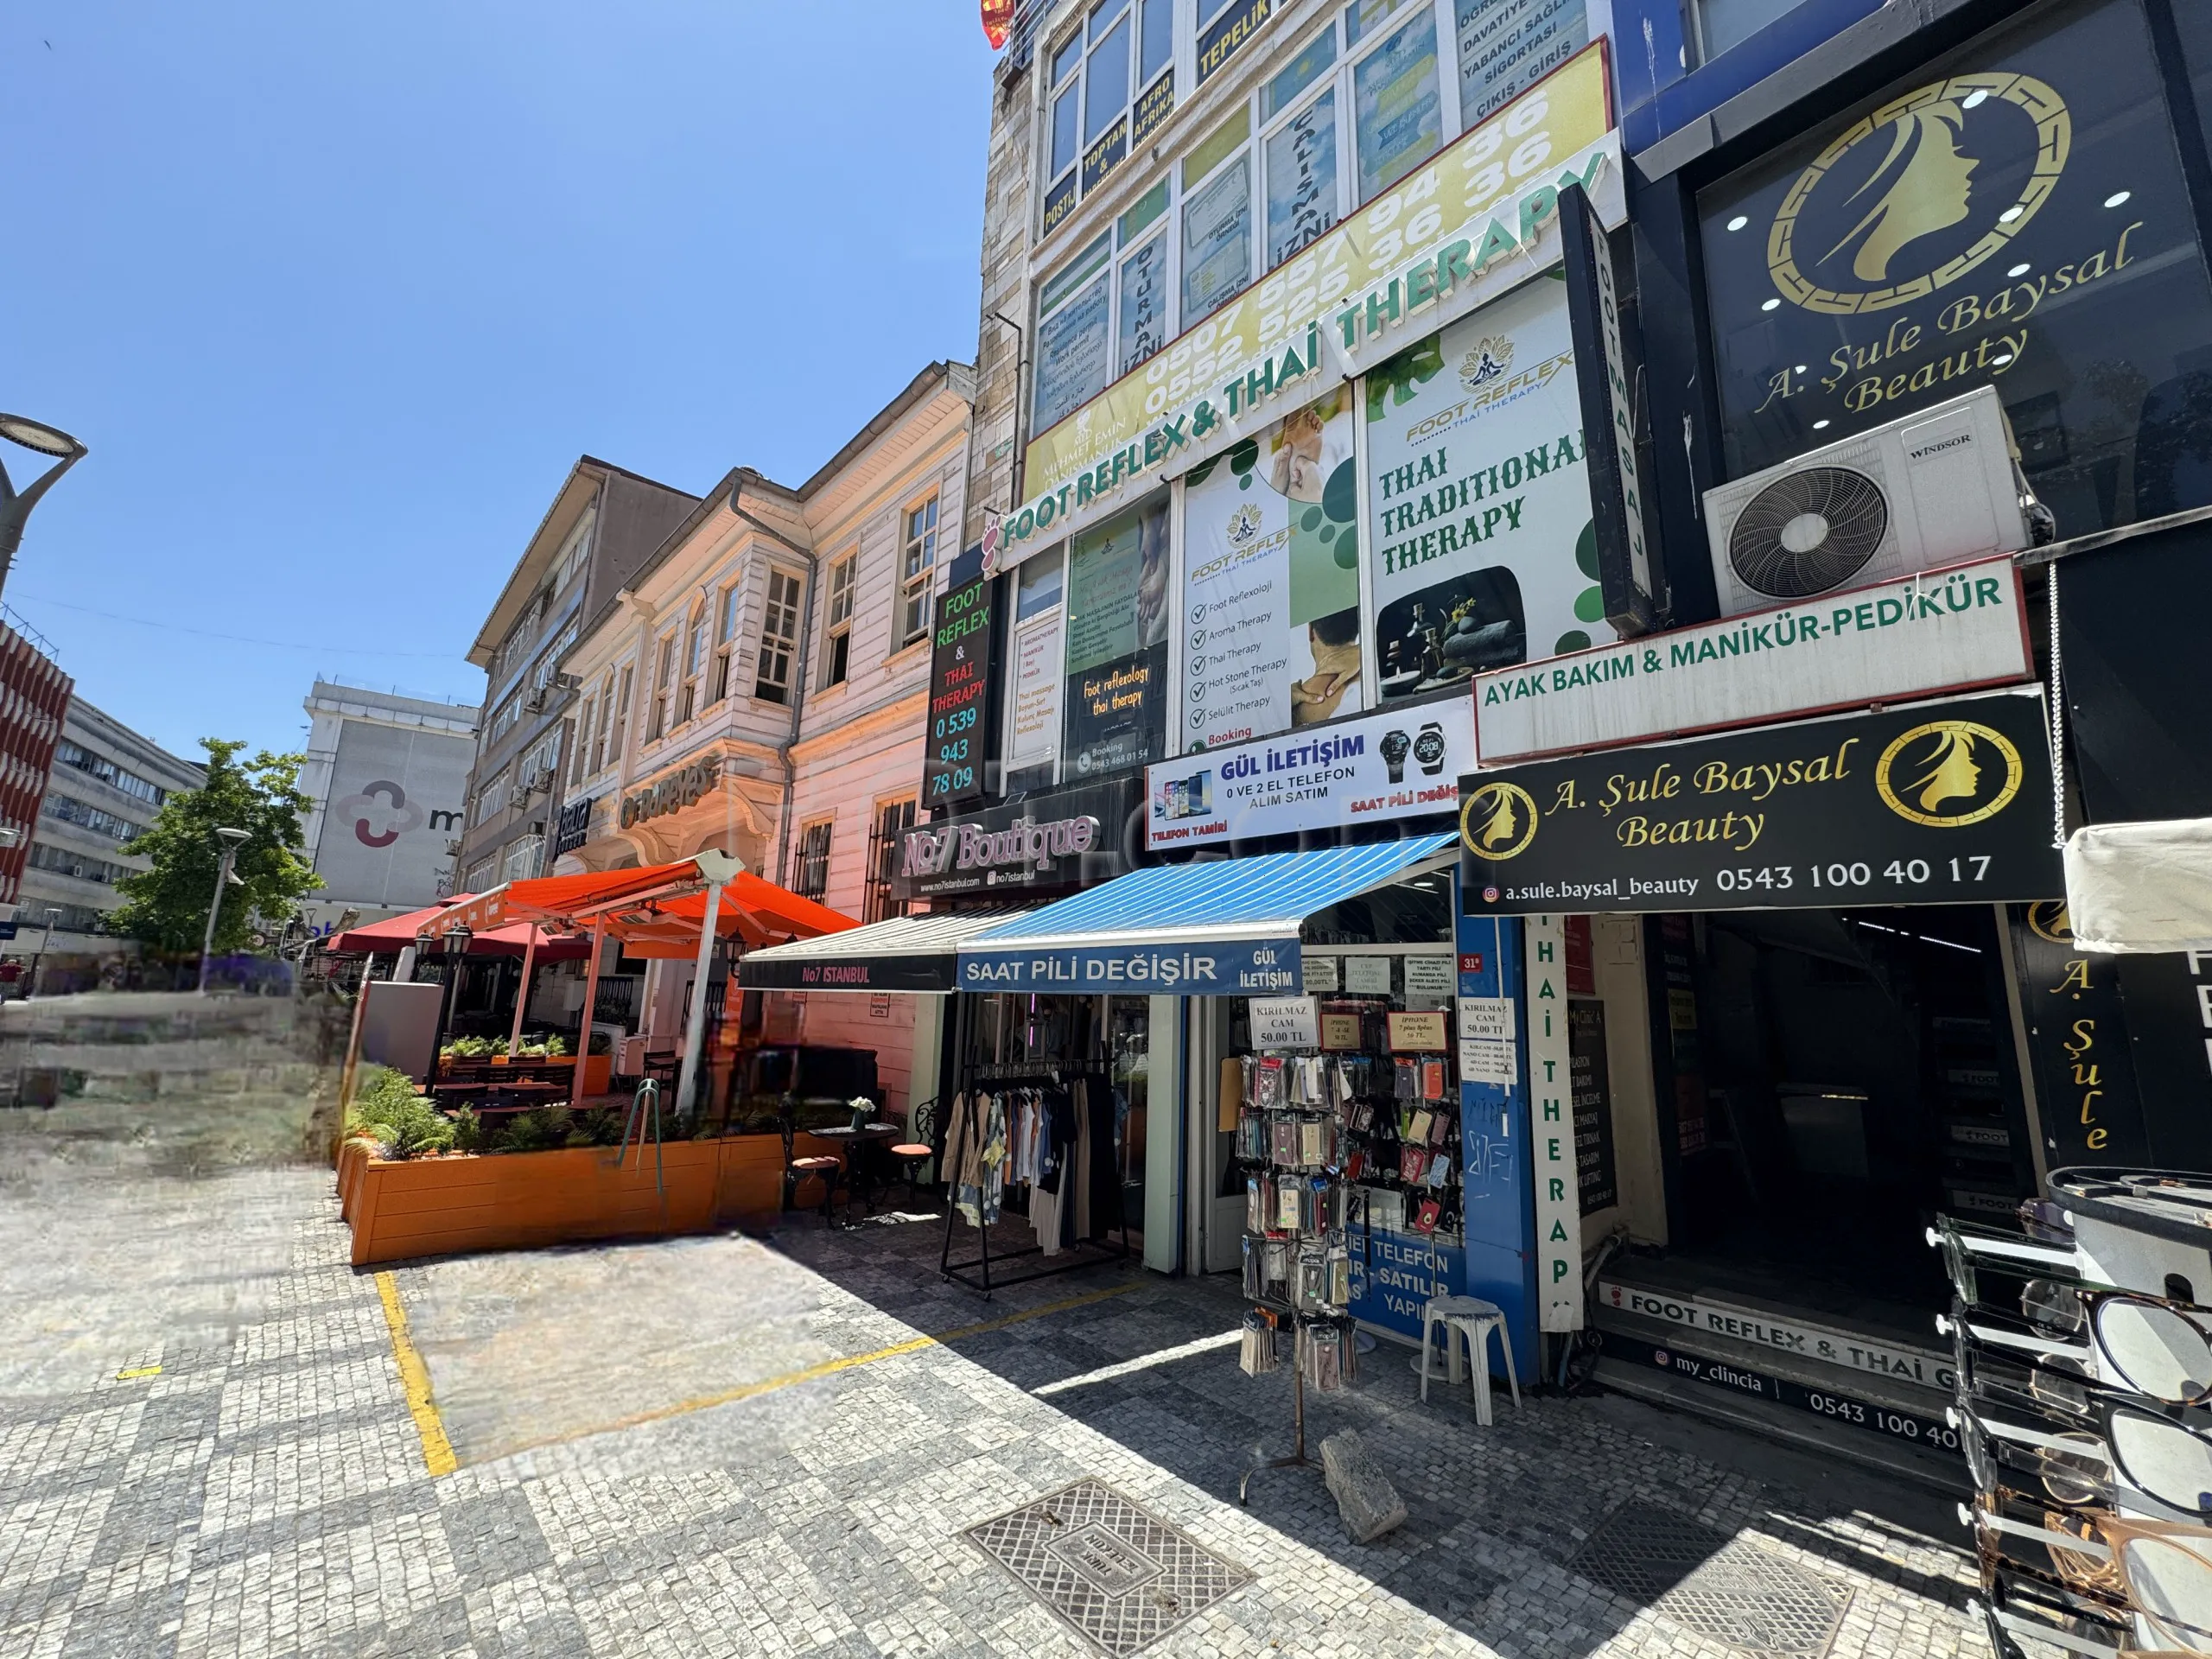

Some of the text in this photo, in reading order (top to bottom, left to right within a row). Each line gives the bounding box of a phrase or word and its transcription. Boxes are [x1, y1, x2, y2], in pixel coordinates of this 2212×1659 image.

[1464, 29, 1521, 79] YABANCI
[1485, 21, 1557, 84] SİGORTASI
[1140, 76, 1170, 116] AFRO
[1477, 41, 1571, 119] ÇIKIŞ GİRİŞ
[1084, 120, 1127, 172] TOPTAN
[1099, 158, 1108, 174] &
[1146, 300, 1243, 385] 0507
[1259, 232, 1347, 309] 557
[1368, 166, 1440, 234] 94
[1463, 90, 1549, 169] 36
[1144, 335, 1243, 414] 0552
[1257, 262, 1350, 344] 525
[1369, 204, 1442, 270] 36
[1465, 131, 1552, 207] 36
[1135, 245, 1153, 349] OTURMA
[1821, 317, 1923, 391] Şule
[1936, 221, 2145, 338] Baysal
[1004, 484, 1072, 549] FOOT
[1077, 414, 1187, 507] REFLEX
[1192, 400, 1217, 438] &
[1337, 152, 1605, 350] THERAPY
[1844, 328, 2030, 415] Beauty
[1406, 351, 1574, 442] FOOT REFLEX
[1484, 381, 1544, 414] THERAPY
[1910, 434, 1972, 460] WINDSOR
[1379, 446, 1447, 501] THAI
[1382, 495, 1526, 575] THERAPY
[1192, 528, 1297, 582] FOOT REFLEX
[1242, 546, 1278, 566] THERAPY
[945, 582, 984, 619] FOOT
[1209, 580, 1272, 613] Foot Reflexoloji
[937, 607, 989, 649] REFLEX
[1210, 612, 1272, 641] Aroma Therapy
[1484, 574, 2003, 707] AYAK BAKIM & MANİKÜR-PEDİKÜR
[956, 645, 965, 660] &
[1210, 642, 1262, 666] Thai Therapy
[944, 661, 974, 687] THAI
[1084, 664, 1149, 699] Foot reflexology
[1209, 658, 1287, 689] Hot Stone Therapy
[932, 679, 985, 714] THERAPY
[1093, 690, 1142, 716] thai therapy
[1208, 696, 1271, 721] Selülit Therapy
[936, 707, 976, 739] 0 539
[1208, 727, 1252, 745] Booking
[941, 739, 969, 765] 943
[1091, 743, 1123, 757] Booking
[1091, 758, 1109, 771] 0543
[1127, 751, 1136, 760] 01
[1138, 748, 1148, 758] 54
[1221, 734, 1365, 780] GÜL İLETİŞİM
[932, 766, 973, 796] 78 09
[1227, 766, 1356, 799] 0 VE 2 EL TELEFON
[1545, 737, 1860, 817] A. Şule Baysal
[1249, 786, 1329, 810] ALIM SATIM
[1351, 798, 1386, 813] SAAT
[1388, 790, 1414, 808] PİLİ
[957, 816, 1097, 869] Boutique
[1152, 820, 1228, 842] TELEFON TAMİRİ
[1617, 810, 1765, 851] Beauty
[920, 869, 1035, 893] www.no7istanbul.com no7istanbul
[1505, 855, 1993, 904] a.sule.baysal_beauty 0543 100 40 17
[966, 953, 1217, 986] SAAT PİLİ DEĞİŞİR
[1253, 949, 1276, 966] GÜL
[802, 966, 870, 983] No7 ISTANBUL
[1239, 968, 1294, 991] İLETİŞİM
[1271, 1019, 1294, 1028] CAM
[1465, 1004, 1507, 1014] KIRILMAZ
[1261, 1032, 1306, 1043] 50.00 TL
[1467, 1025, 1490, 1033] 50.00
[2063, 1020, 2108, 1150] Şule
[1374, 1241, 1449, 1274] TELEFON
[1380, 1268, 1449, 1297] SATILIR
[1632, 1294, 1699, 1325] FOOT
[1707, 1312, 1806, 1351] REFLEX
[1816, 1338, 1837, 1360] &
[1676, 1357, 1959, 1450] my_clincia 0543 100 40
